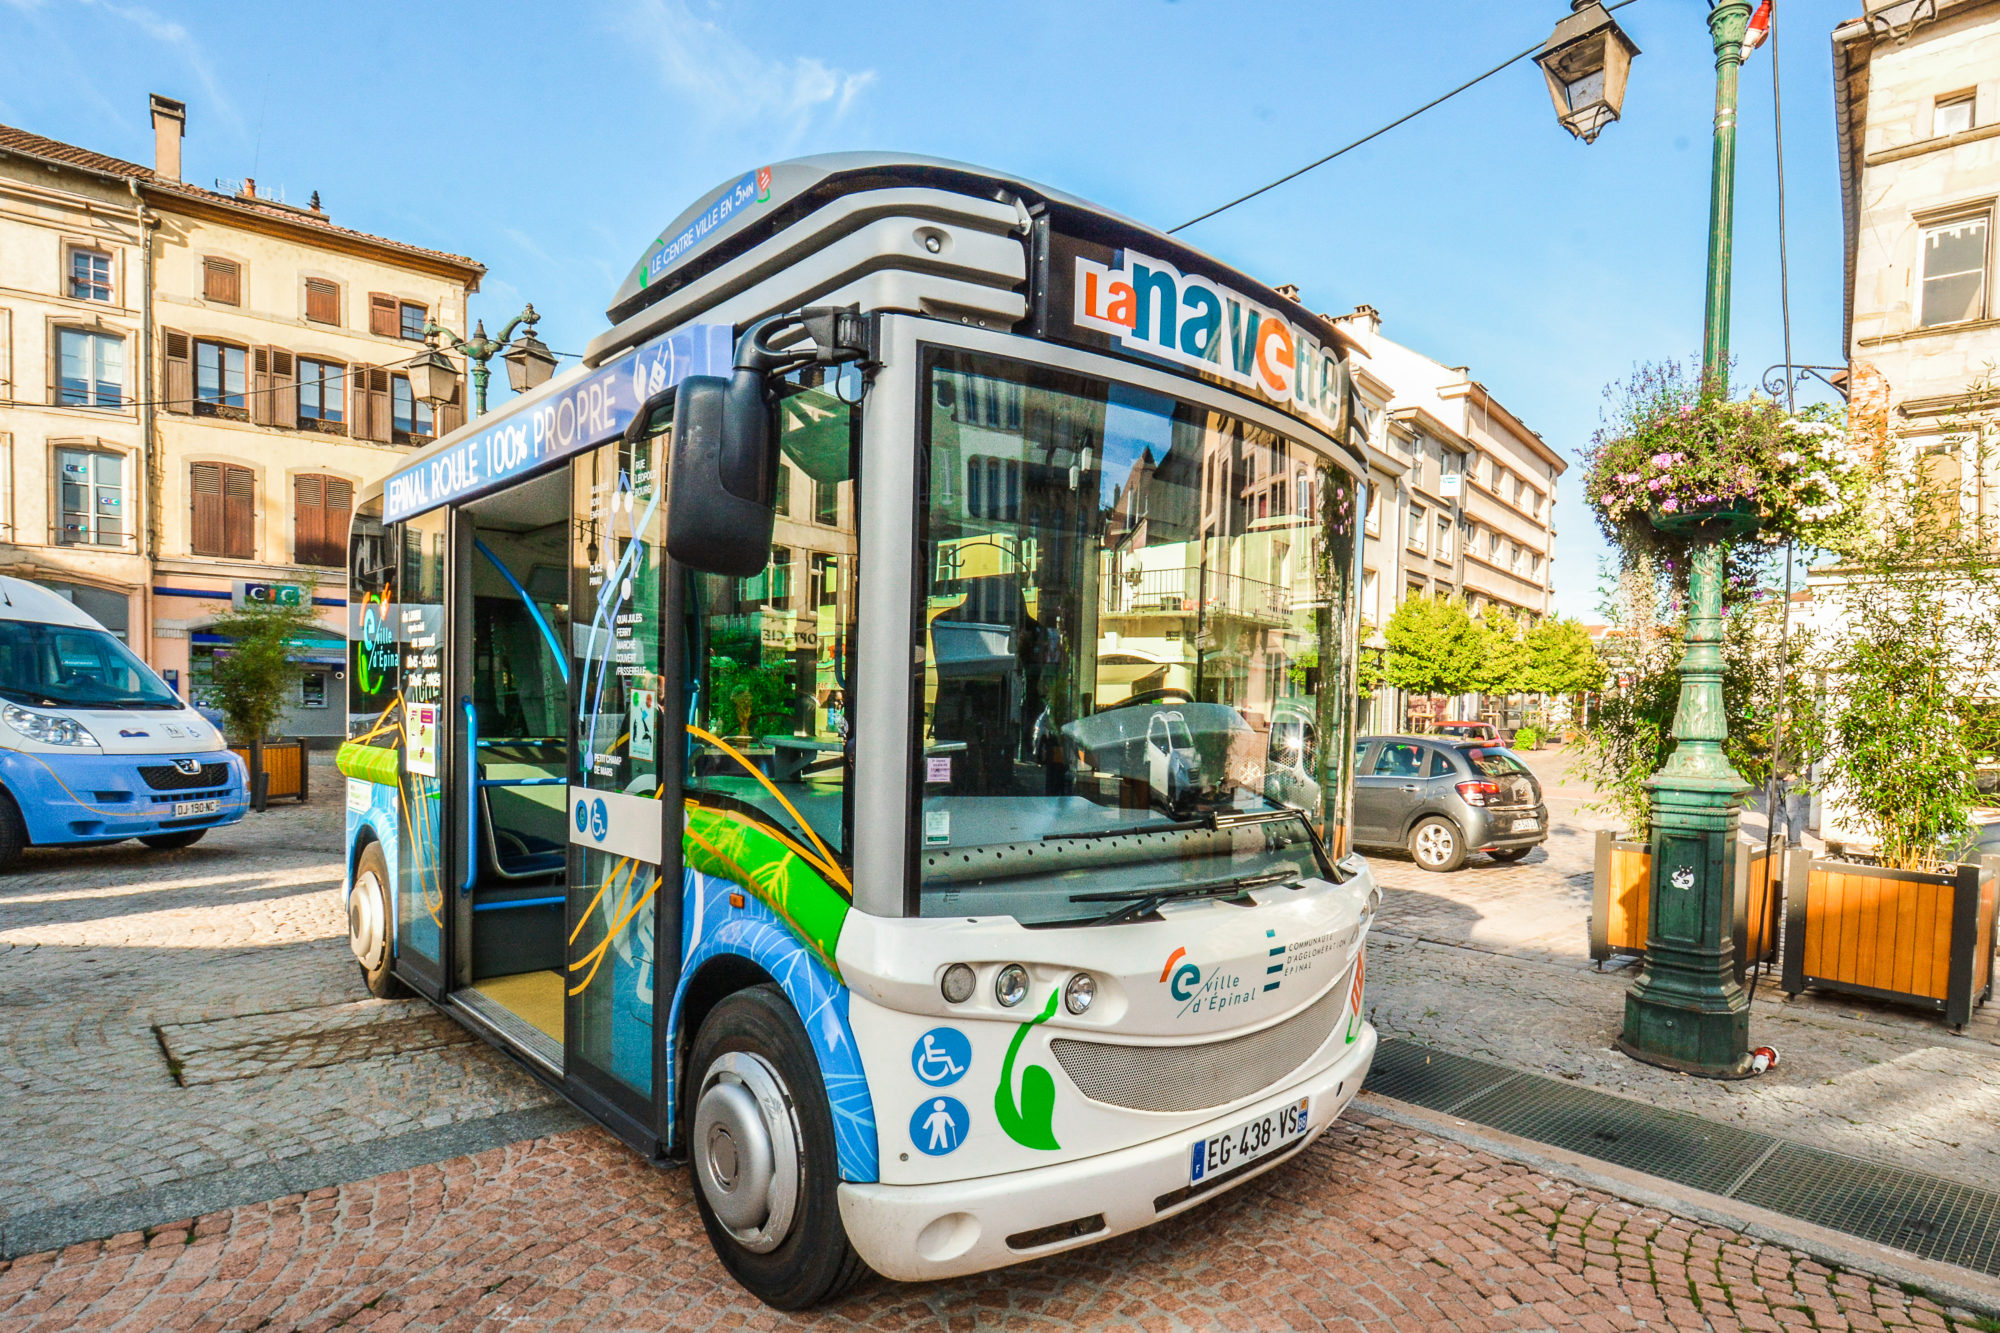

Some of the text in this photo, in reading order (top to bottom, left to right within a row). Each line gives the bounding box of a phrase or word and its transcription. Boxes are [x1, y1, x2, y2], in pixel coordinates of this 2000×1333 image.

[652, 254, 663, 274] LE
[663, 228, 694, 265] CENTRE
[695, 207, 719, 238] VILLE
[720, 196, 733, 219] EN
[388, 374, 617, 517] EPINAL ROULE 100% PROPRE
[250, 587, 295, 602] CIC
[1192, 987, 1256, 1013] d'Épinal
[1195, 1164, 1201, 1174] F
[1207, 1105, 1298, 1172] EG-438-VS
